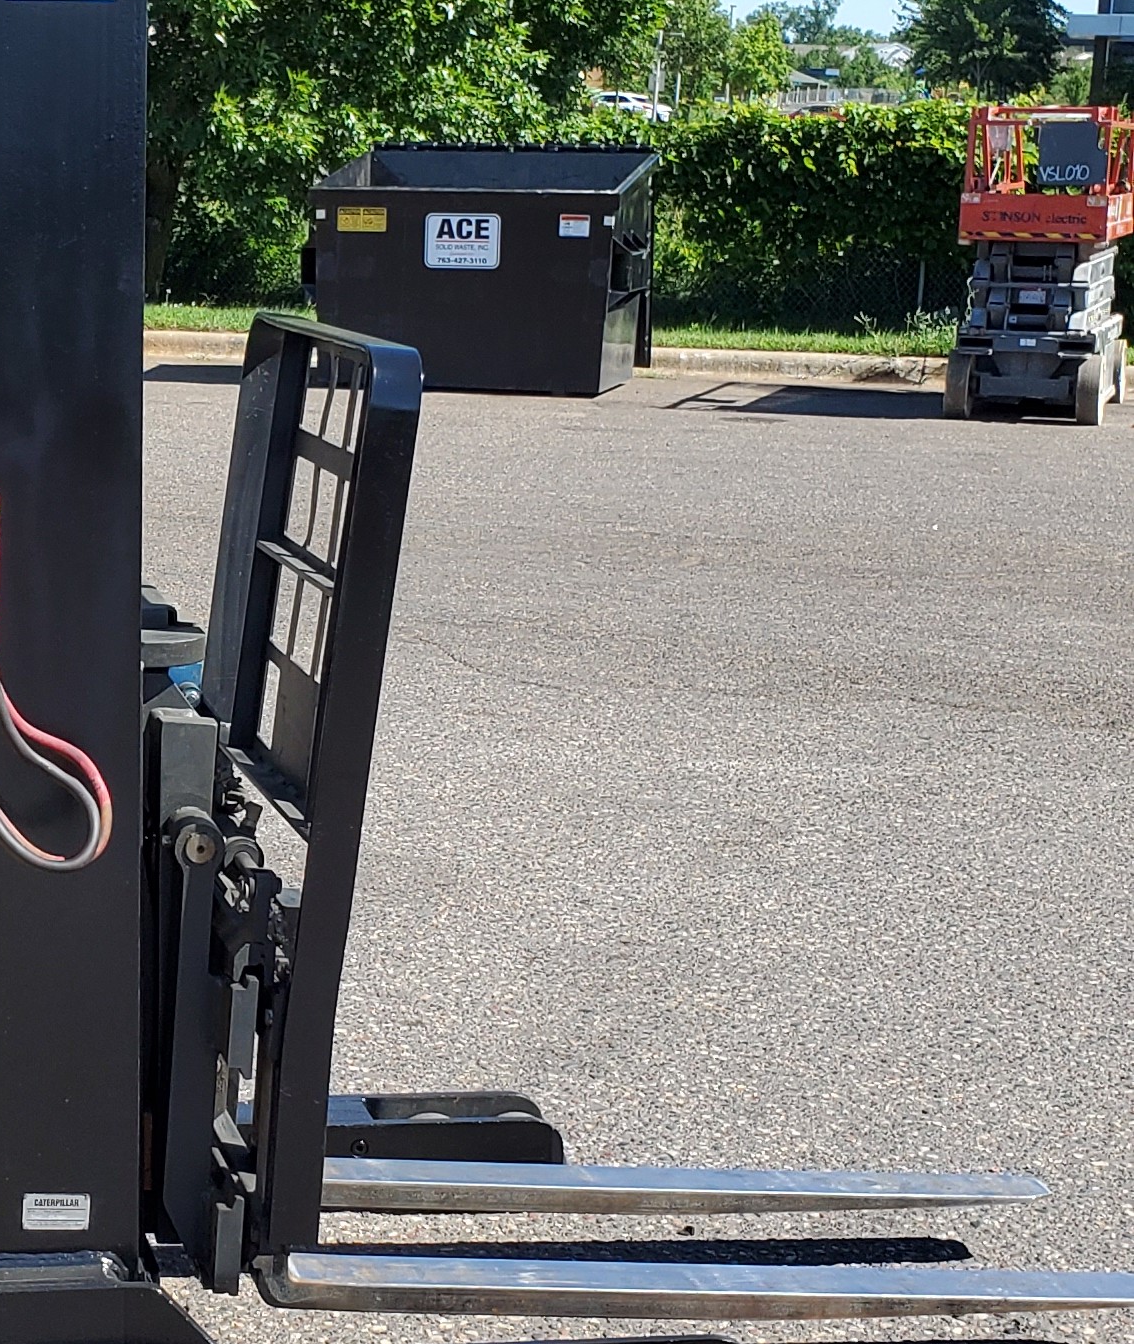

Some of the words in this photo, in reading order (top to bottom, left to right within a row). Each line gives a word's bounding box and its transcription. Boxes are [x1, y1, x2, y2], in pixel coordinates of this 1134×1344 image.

[435, 218, 490, 240] ACE
[435, 243, 453, 251] SOLID
[34, 1198, 80, 1207] CATERPILLAR
